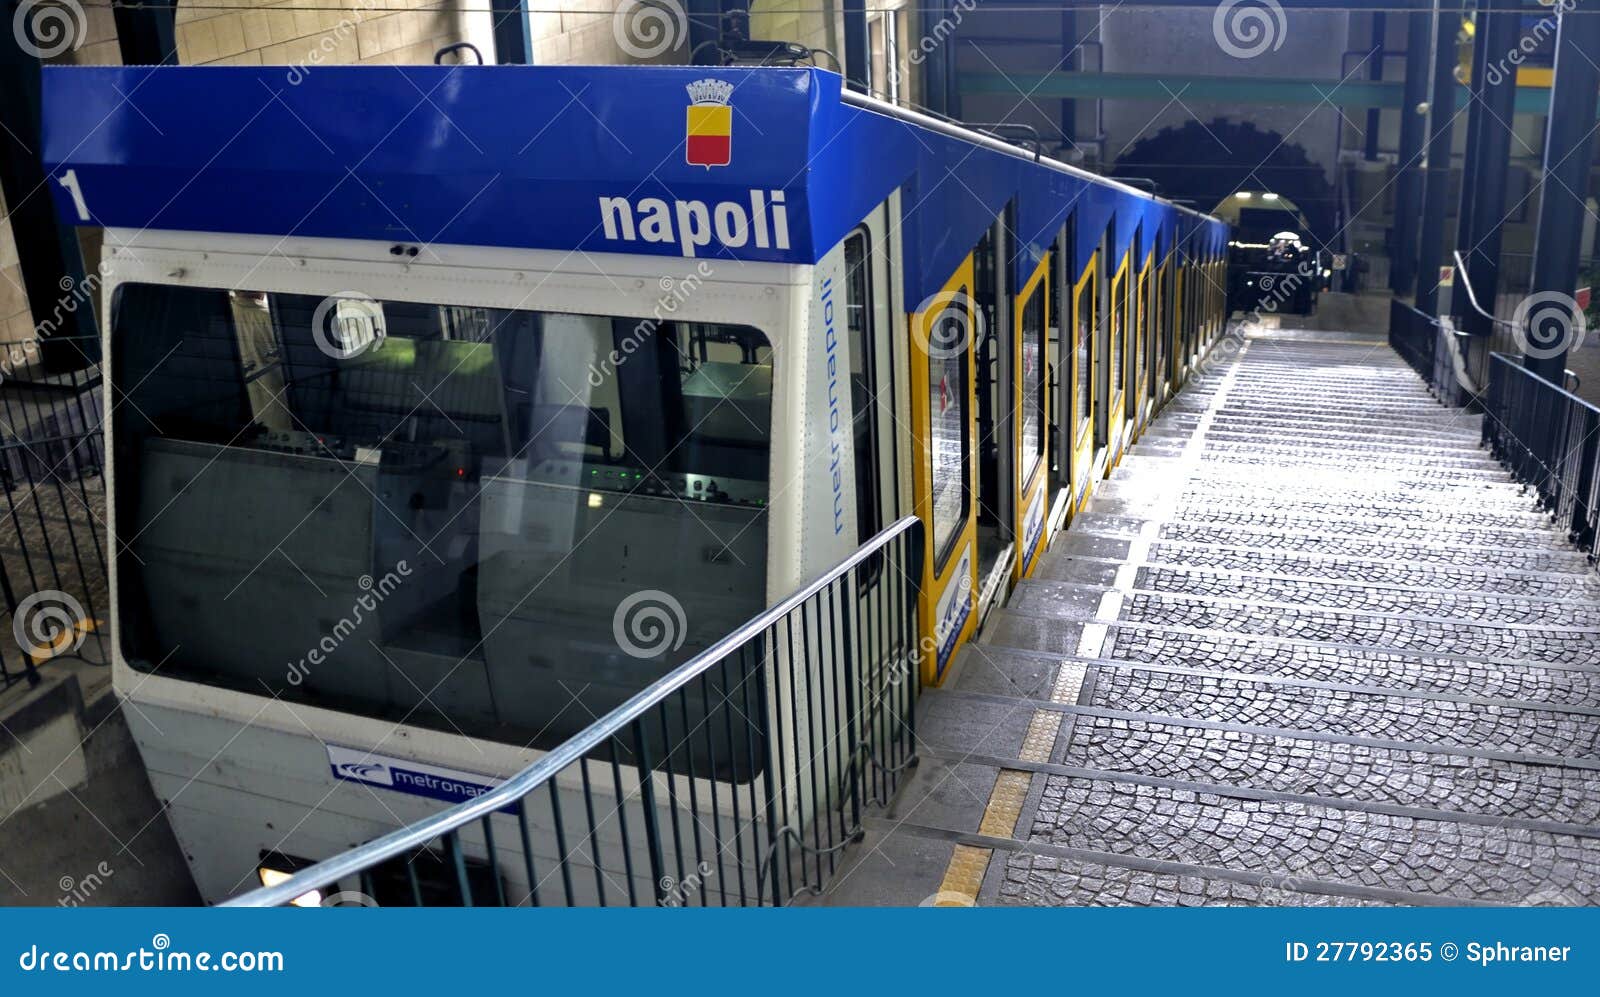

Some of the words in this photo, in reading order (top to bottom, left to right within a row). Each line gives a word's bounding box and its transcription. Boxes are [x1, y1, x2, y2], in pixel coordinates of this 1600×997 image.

[59, 169, 91, 220] 1
[599, 189, 791, 258] napoli
[820, 277, 844, 536] metronapoli
